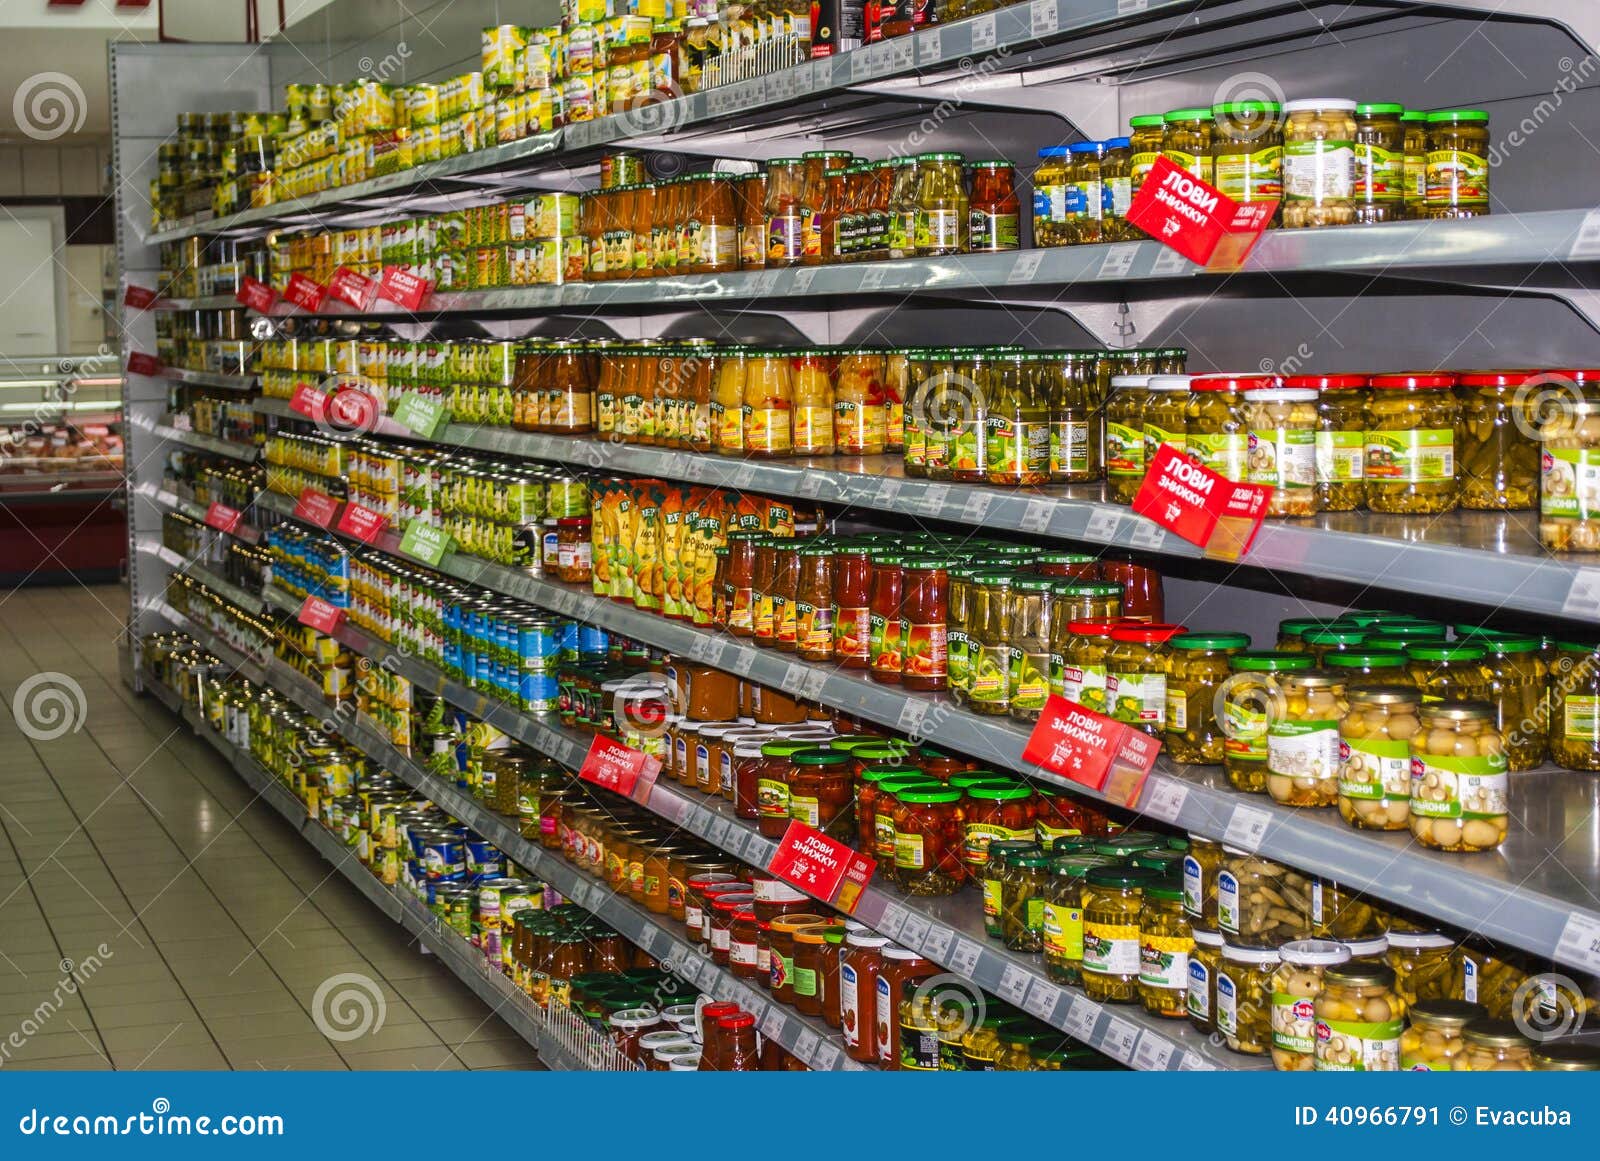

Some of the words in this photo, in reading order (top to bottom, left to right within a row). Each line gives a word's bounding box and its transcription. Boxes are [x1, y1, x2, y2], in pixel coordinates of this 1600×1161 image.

[1155, 187, 1208, 227] ЗНИЖКУ!
[1162, 170, 1219, 214] ЛОВИ
[390, 271, 420, 289] ЛОВИ
[1165, 456, 1215, 495] ЛОВИ
[1158, 475, 1205, 510] ЗНИЖКУ!
[1051, 717, 1108, 751] ЗНИЖКУ!
[1066, 710, 1103, 735] ЛОВИ
[607, 745, 631, 760] ЛОВИ
[792, 839, 838, 870] ЗНИЖКУ!
[805, 836, 835, 856] ЛОВИ
